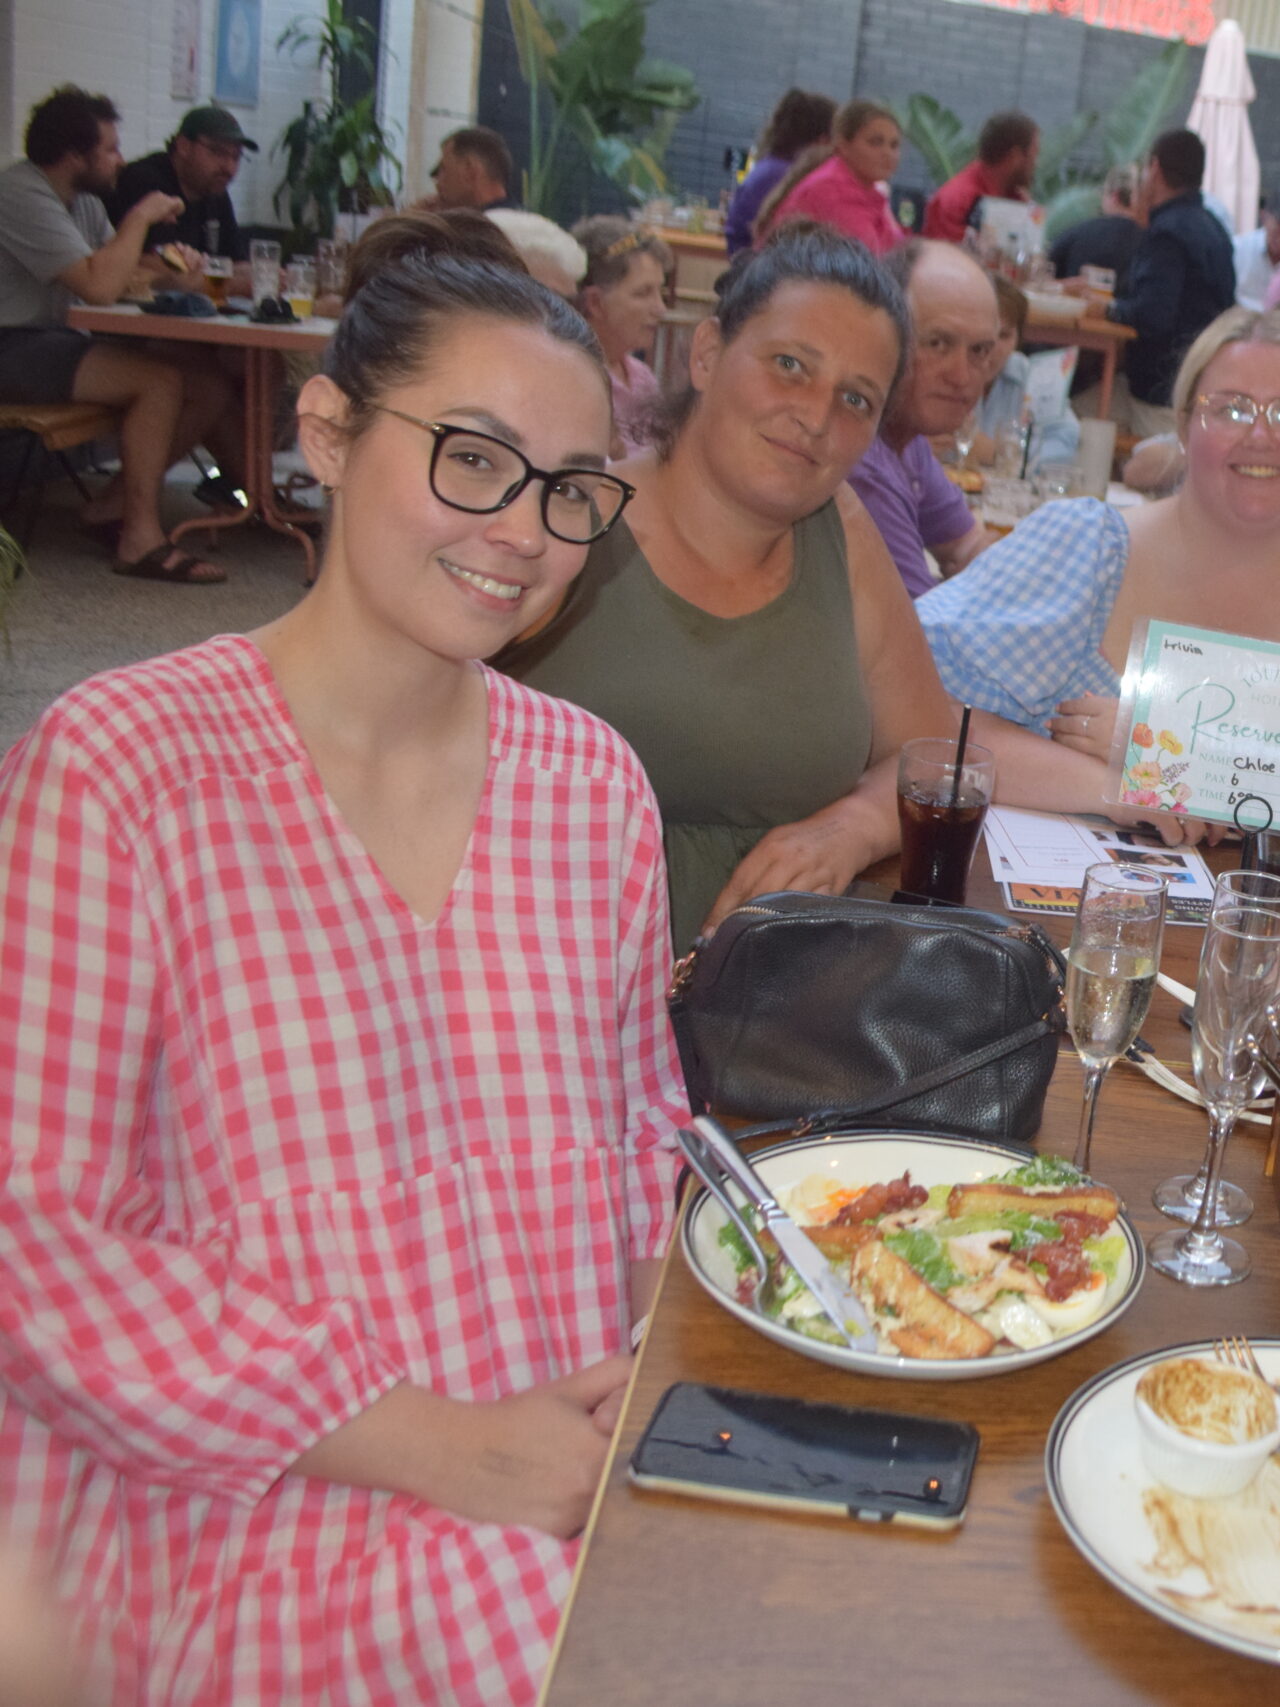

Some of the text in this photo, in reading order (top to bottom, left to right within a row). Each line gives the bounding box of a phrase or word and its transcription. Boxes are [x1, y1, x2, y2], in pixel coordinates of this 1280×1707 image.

[1164, 639, 1203, 656] trivia
[1200, 752, 1233, 767] NAME
[1233, 757, 1276, 774] Chloe
[1204, 772, 1239, 786] PAX 6
[1198, 788, 1226, 801] TIME
